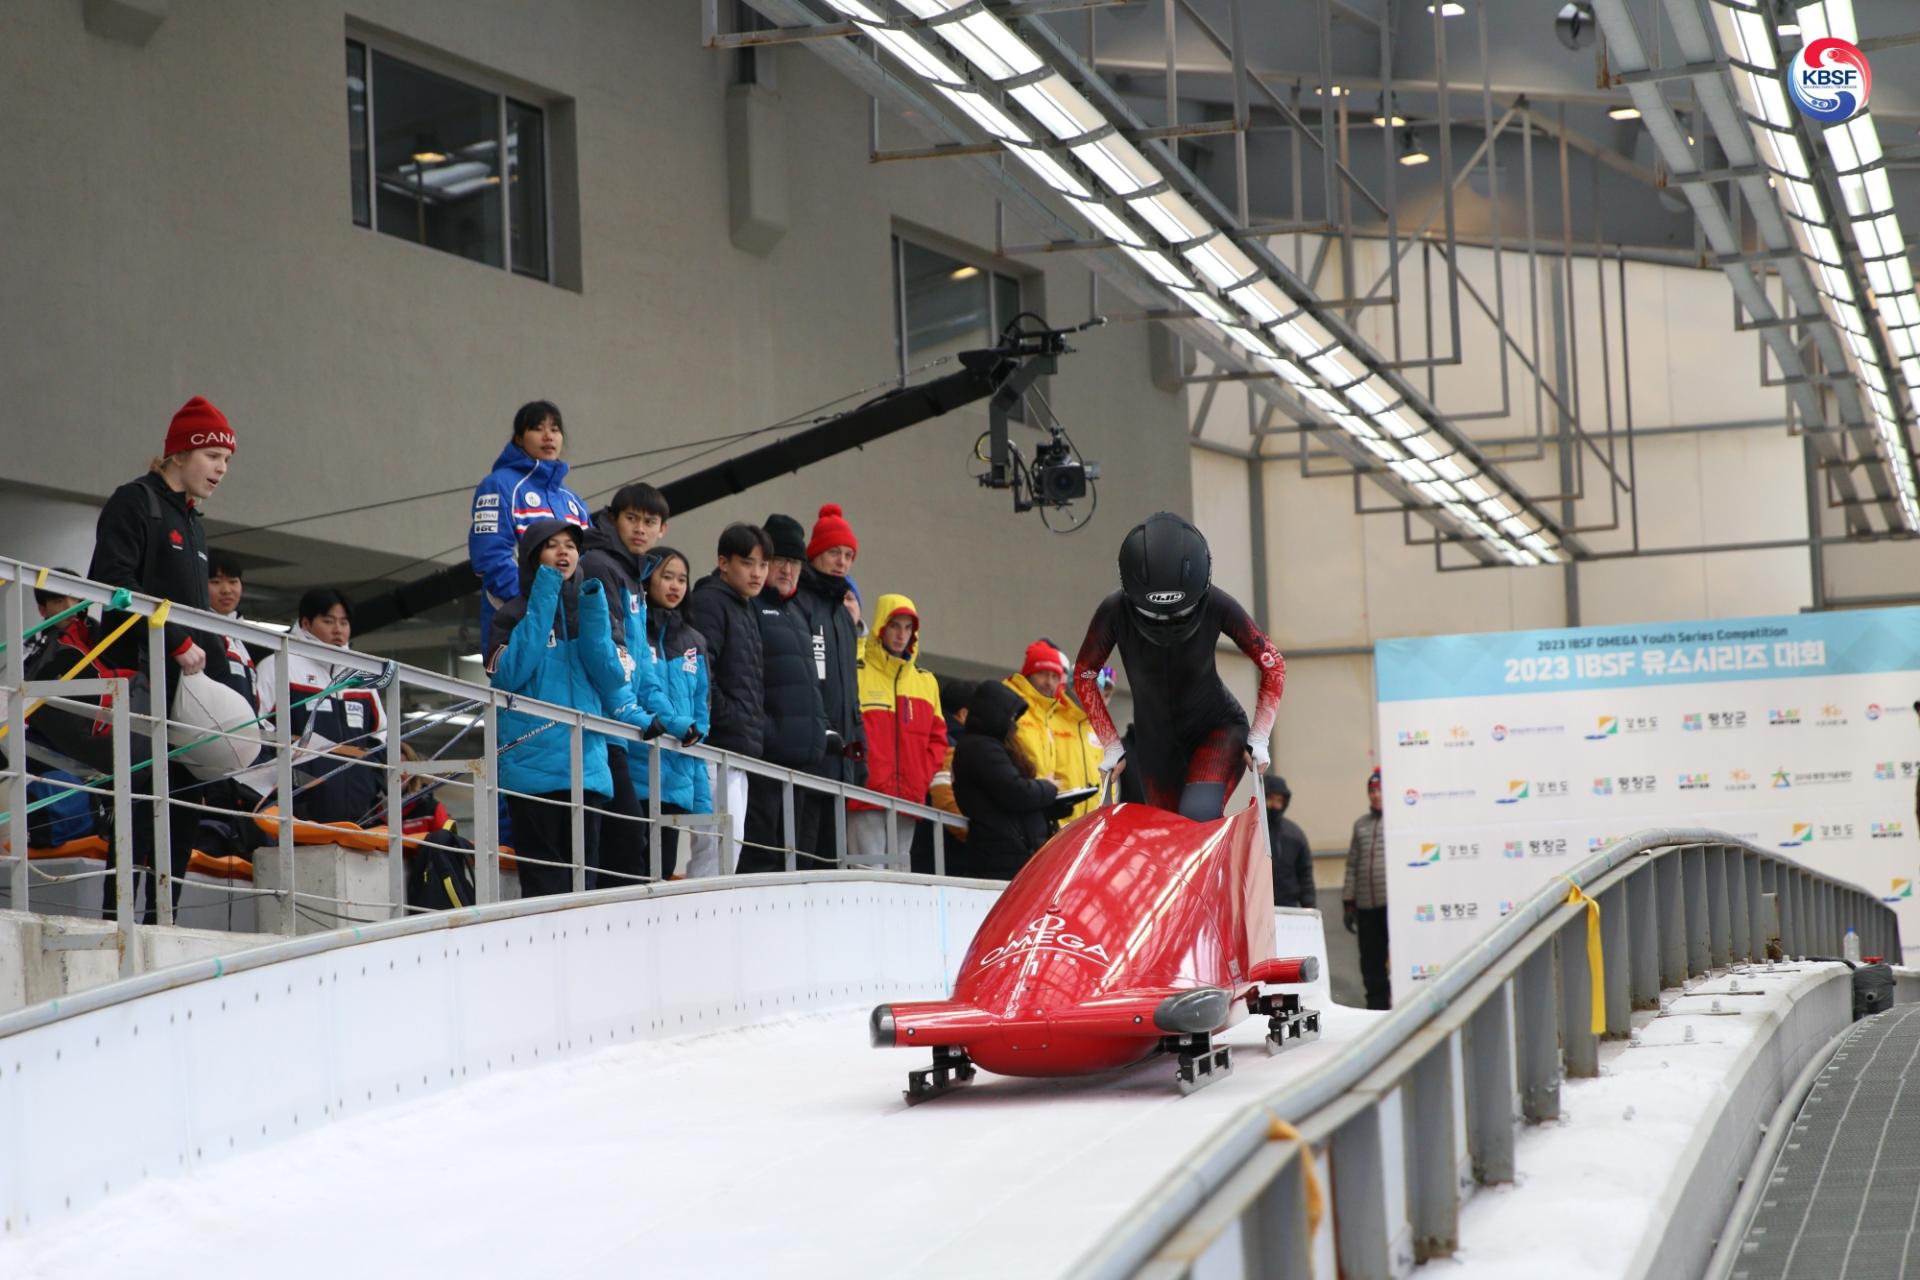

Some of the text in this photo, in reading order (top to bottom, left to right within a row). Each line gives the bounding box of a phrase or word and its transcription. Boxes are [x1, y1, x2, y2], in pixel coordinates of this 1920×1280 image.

[1537, 626, 1789, 651] 2023 IBSF OMEGA Youth Series Competition
[1504, 640, 1825, 683] 2023 IBSF 유스시리즈 대회
[980, 931, 1110, 965] OMEGA
